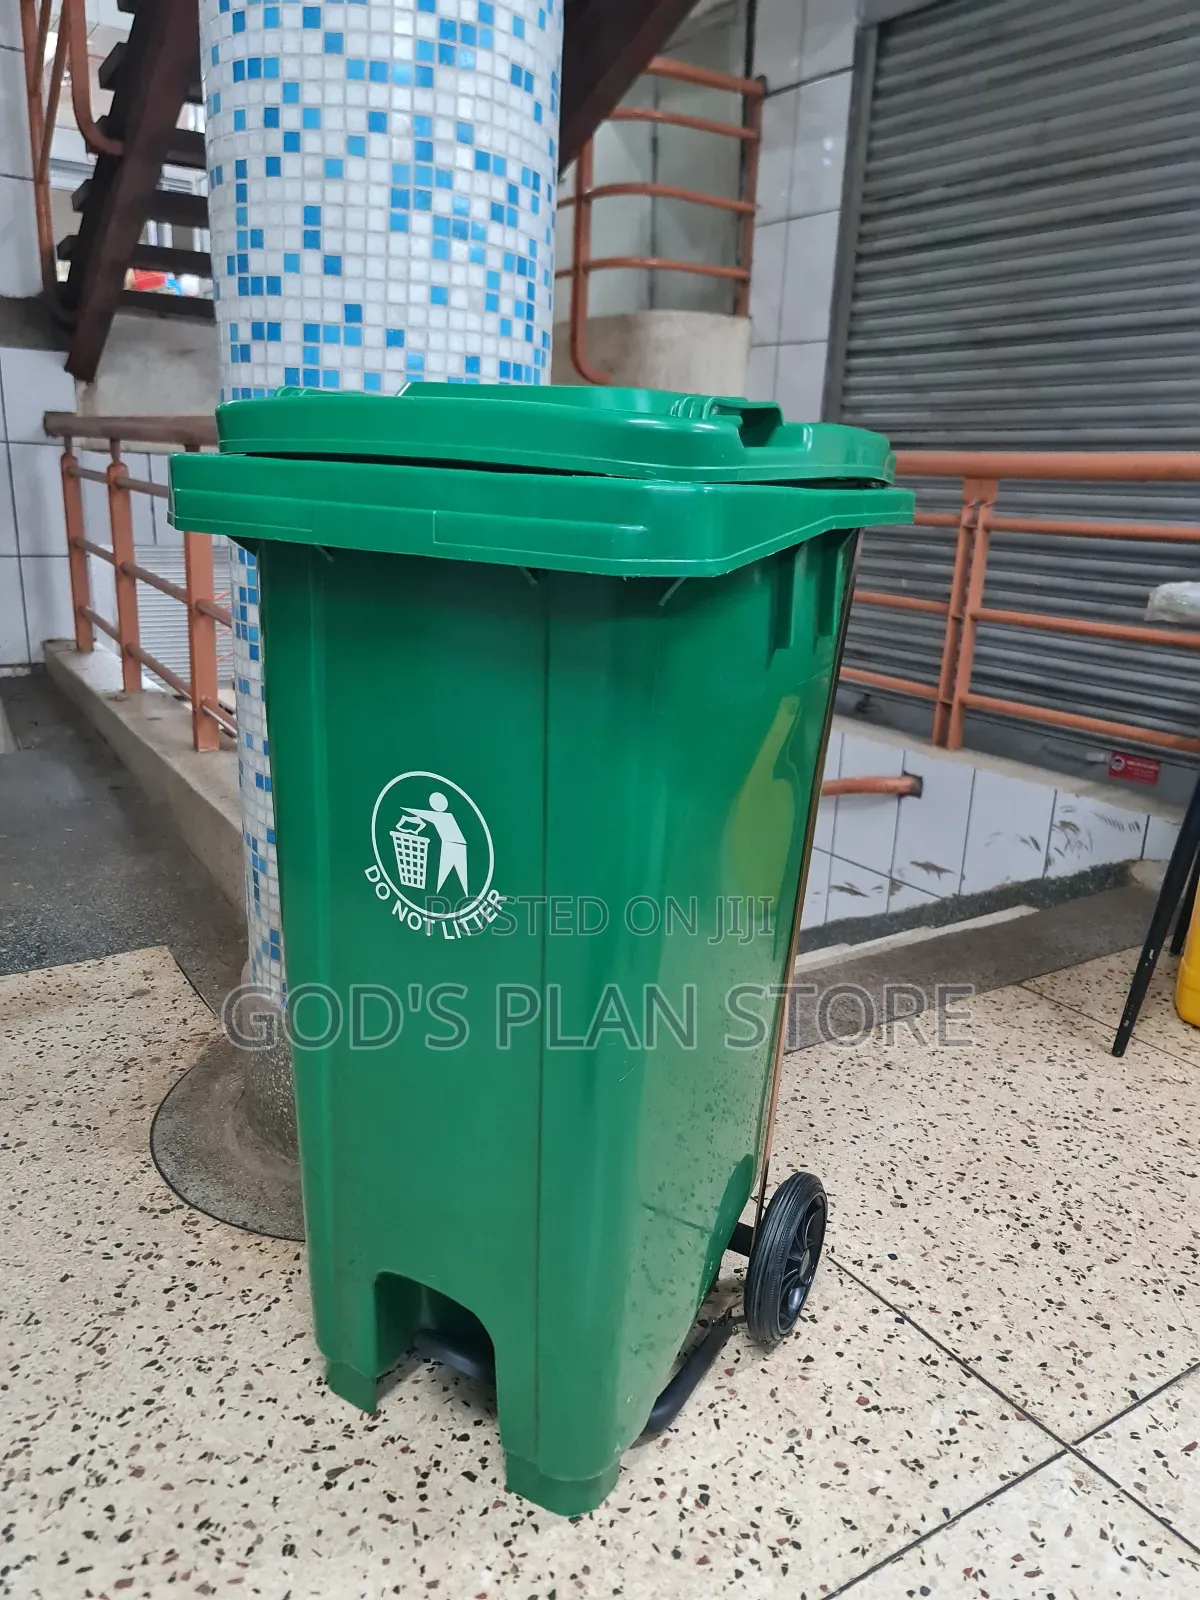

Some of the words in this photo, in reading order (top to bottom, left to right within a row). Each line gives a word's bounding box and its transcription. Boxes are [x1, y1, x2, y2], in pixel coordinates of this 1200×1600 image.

[364, 864, 391, 901] DO
[391, 899, 436, 937] NOT
[441, 889, 508, 940] LITTER
